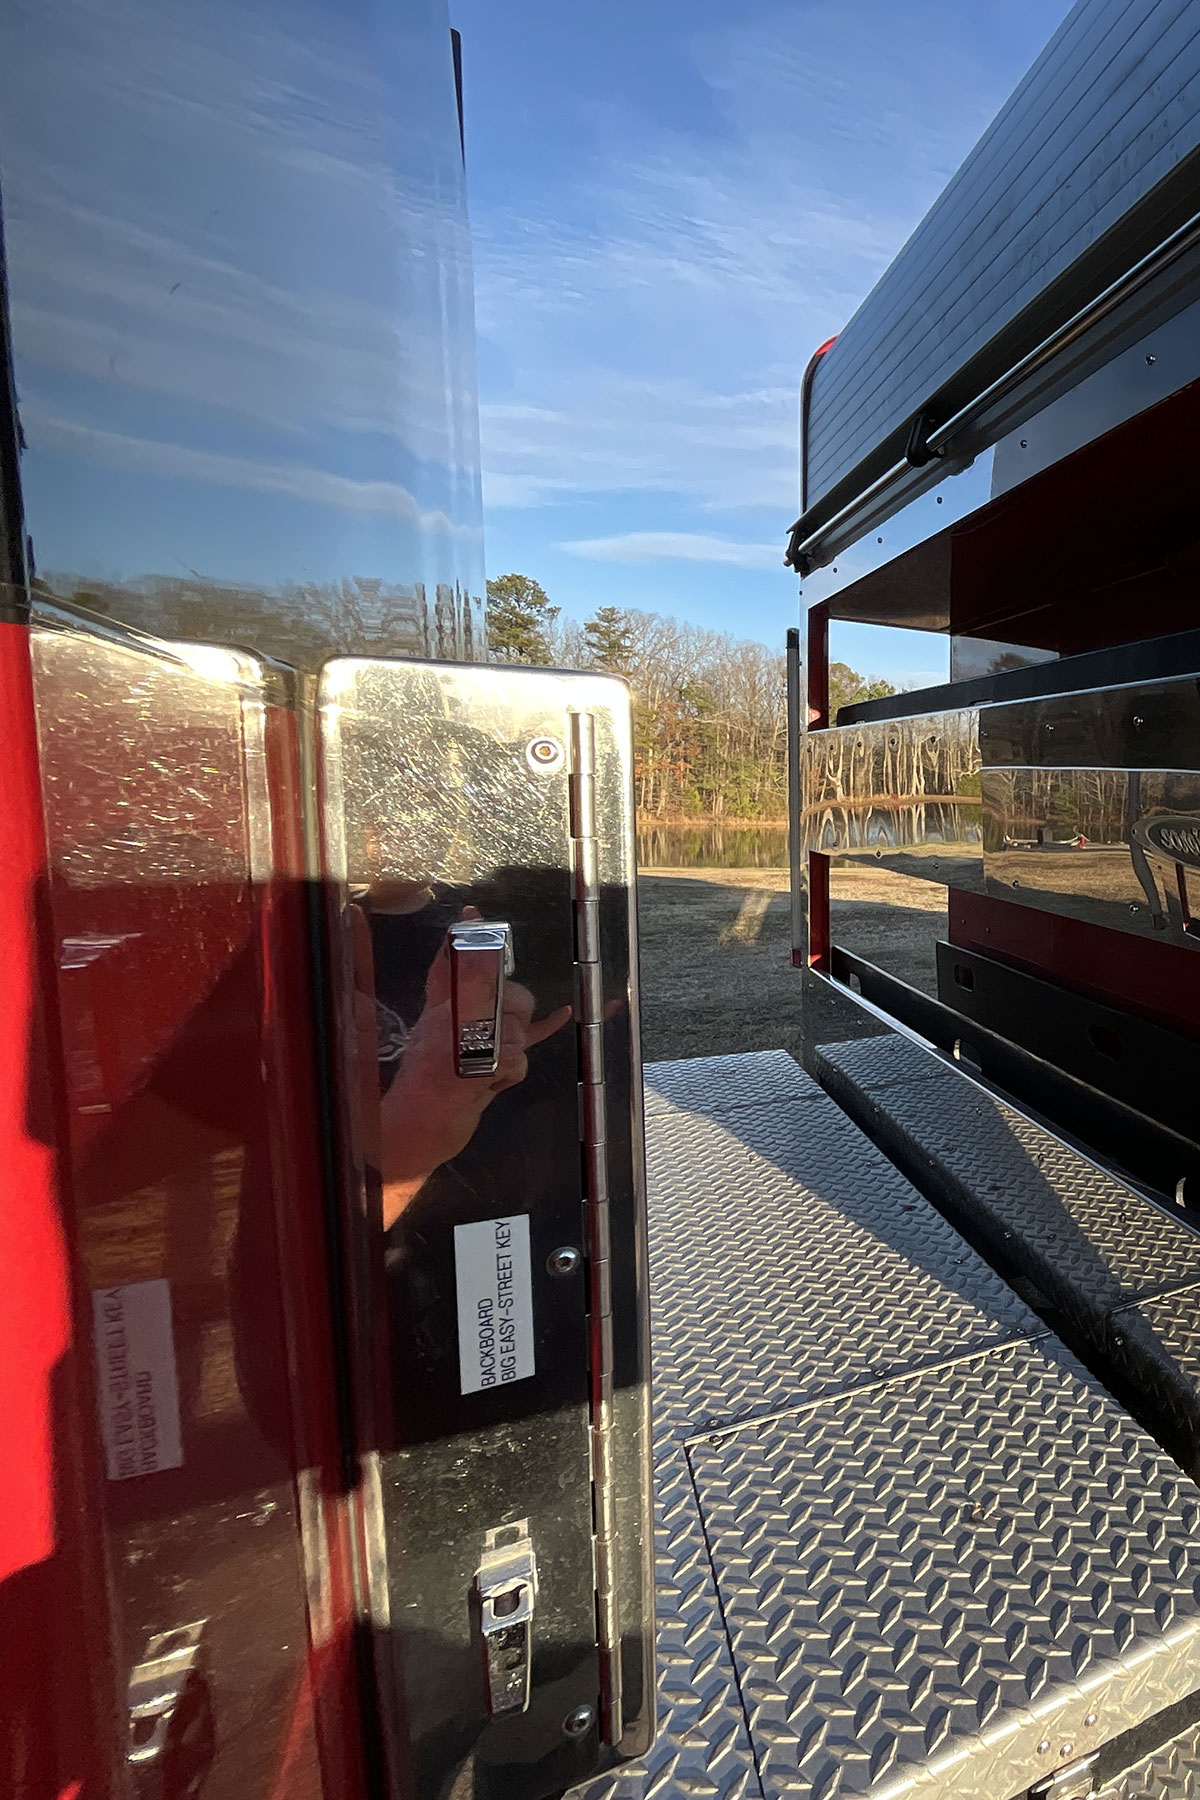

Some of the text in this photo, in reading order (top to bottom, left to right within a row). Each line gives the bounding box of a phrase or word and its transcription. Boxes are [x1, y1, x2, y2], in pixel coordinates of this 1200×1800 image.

[495, 1221, 511, 1250] KEY
[477, 1298, 496, 1387] BACKBOARD
[500, 1356, 516, 1382] BIG
